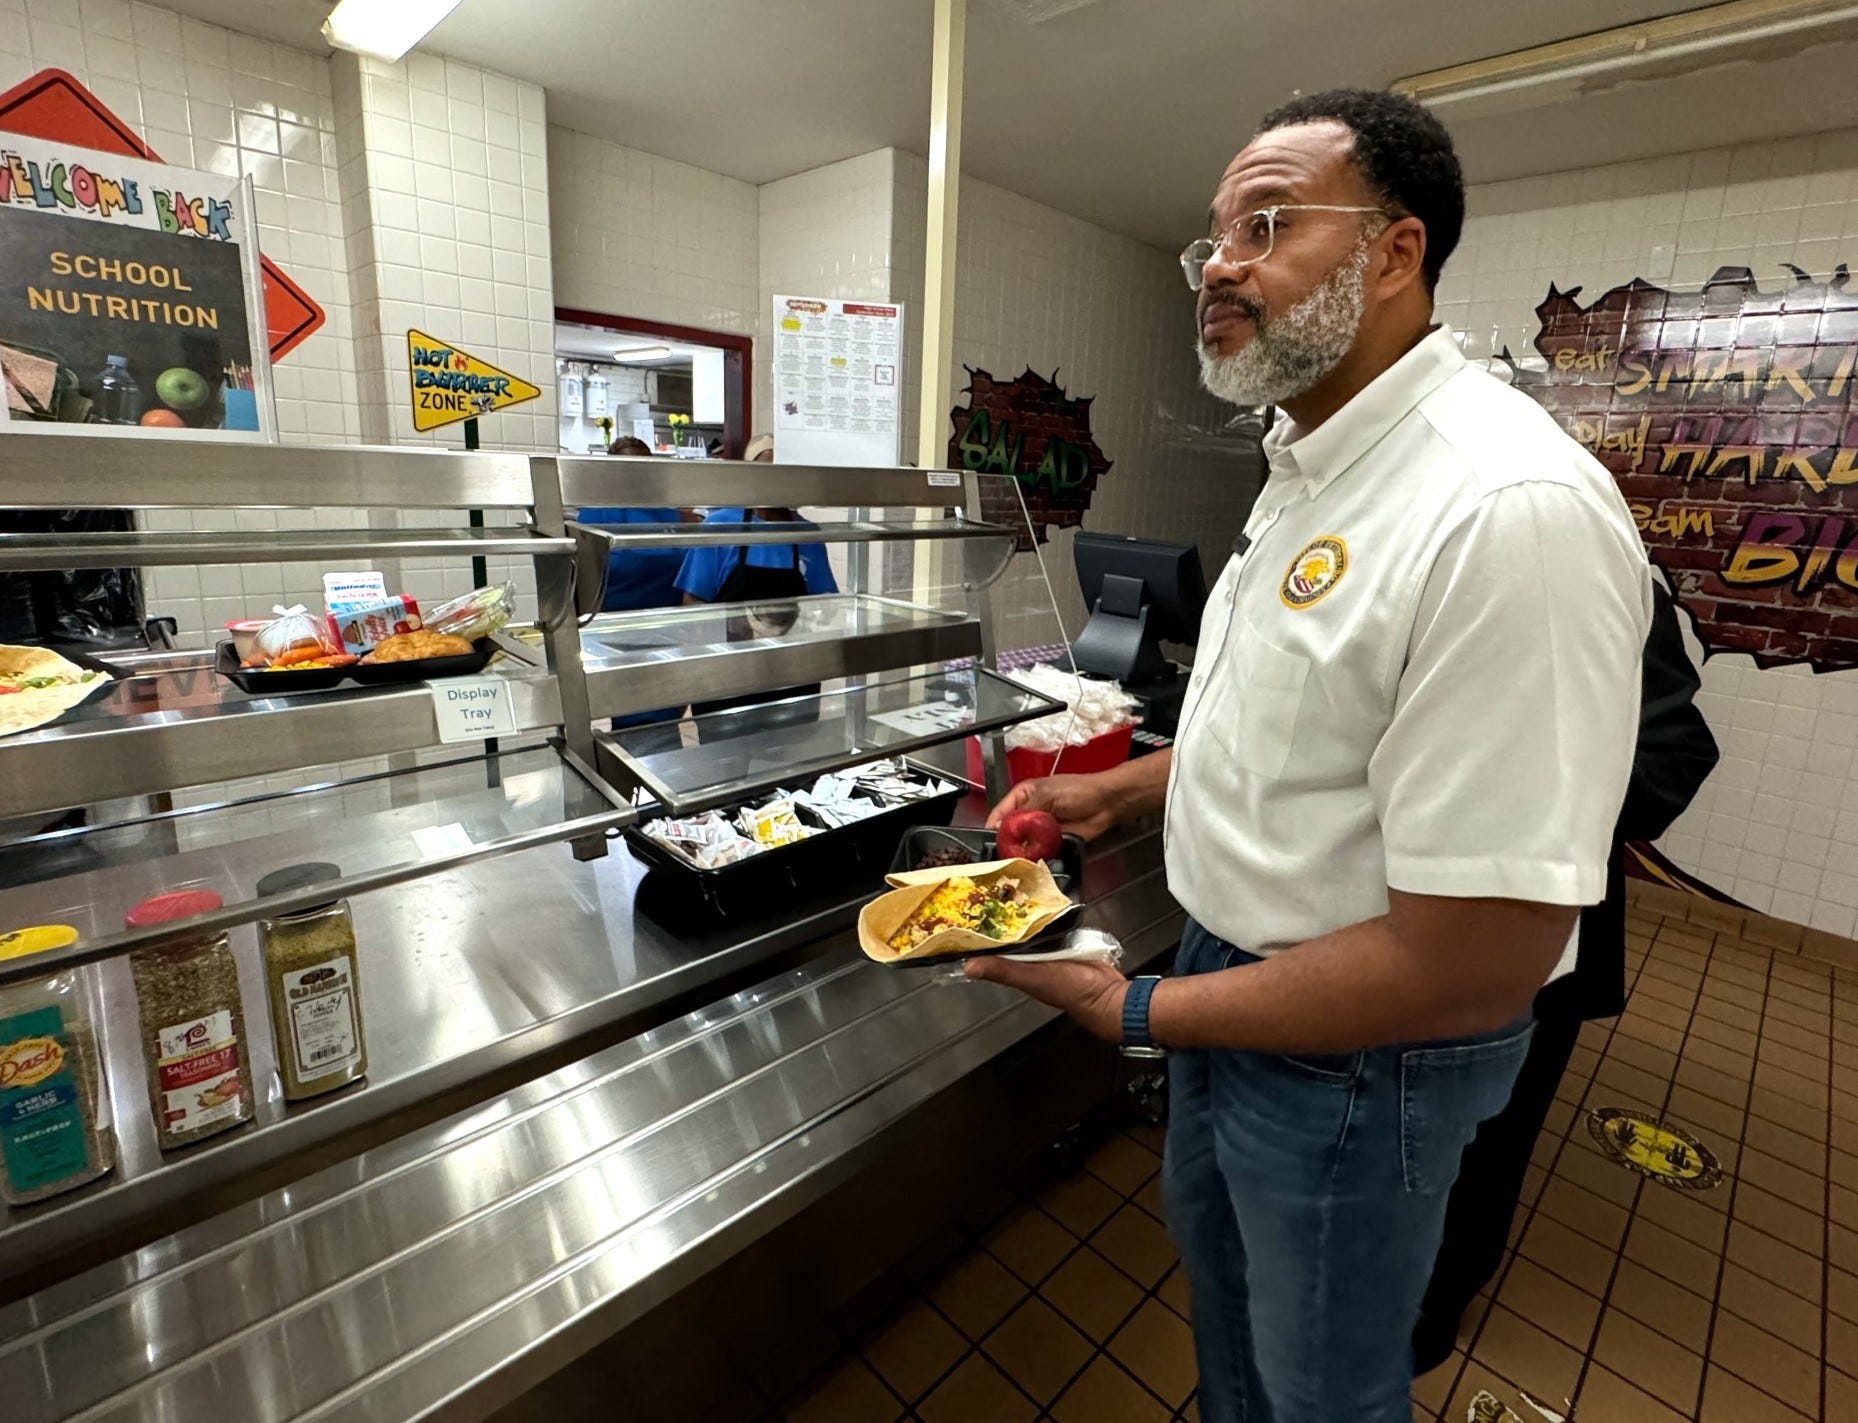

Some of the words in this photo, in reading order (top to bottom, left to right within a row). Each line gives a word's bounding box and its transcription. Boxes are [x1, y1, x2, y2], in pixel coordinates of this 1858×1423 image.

[153, 190, 231, 241] BACK
[50, 251, 192, 292] SCHOOL
[27, 286, 218, 330] NUTRITION
[413, 346, 454, 369] HOT
[1554, 343, 1614, 373] eat
[420, 392, 467, 411] ZONE
[960, 409, 1089, 490] SALAD
[1630, 504, 1715, 538] eam
[447, 687, 497, 701] Display
[460, 708, 492, 720] Tray
[0, 1044, 60, 1084] Dash
